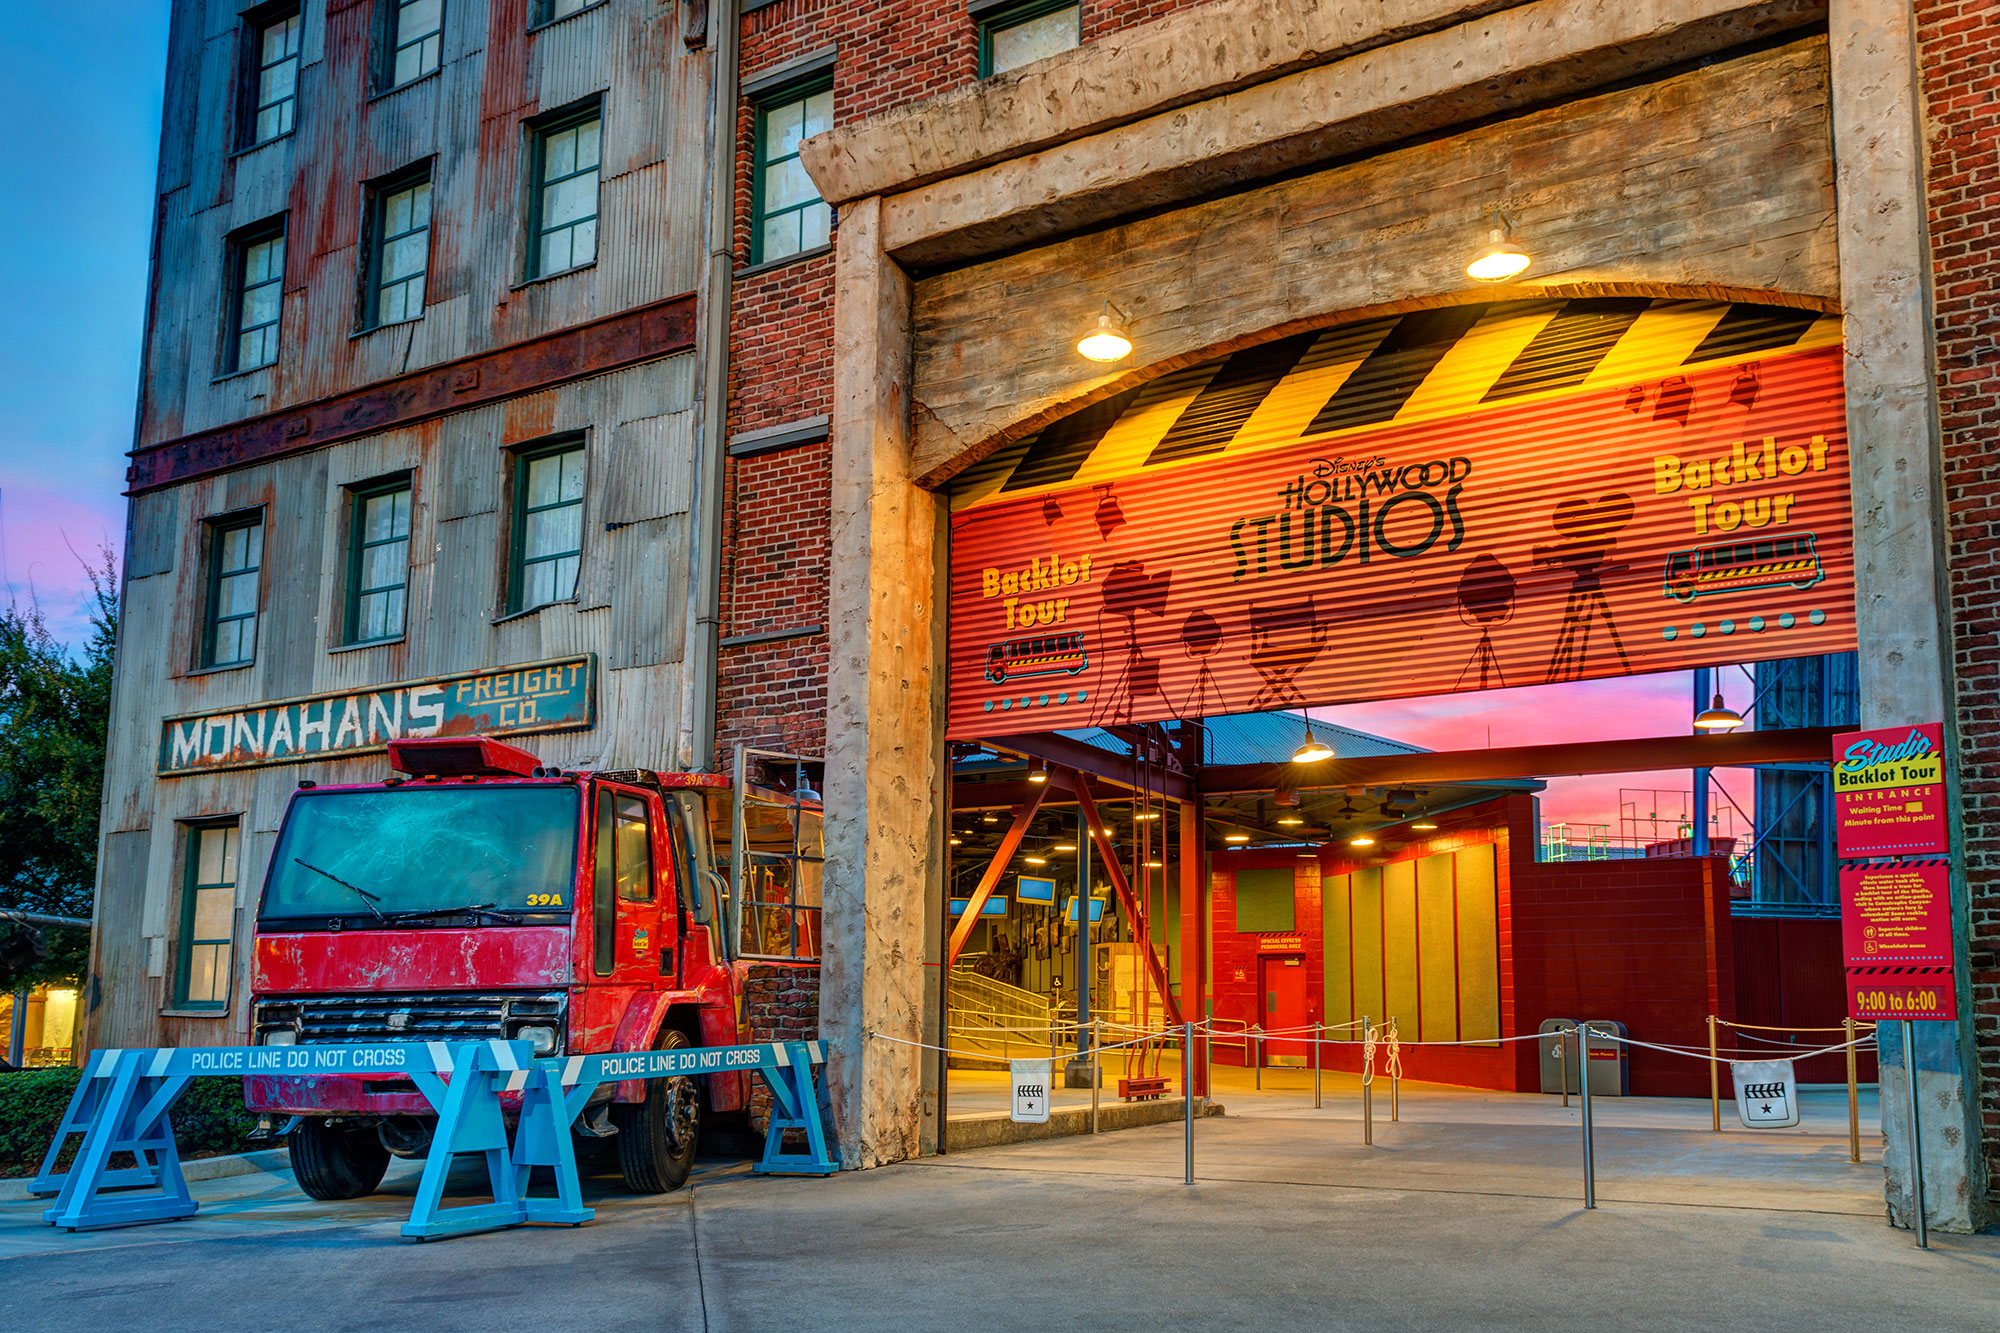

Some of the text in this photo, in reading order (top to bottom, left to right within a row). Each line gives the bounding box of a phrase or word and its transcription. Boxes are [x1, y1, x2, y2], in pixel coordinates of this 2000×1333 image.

[1654, 435, 1829, 494] Backlot
[1278, 457, 1471, 510] HOLLYWOOD
[1688, 493, 1795, 534] Tour
[1230, 483, 1464, 582] STUDIOS
[982, 554, 1092, 598] Backlot
[1003, 598, 1070, 630] Tour
[457, 662, 583, 702] FREIGHT
[500, 699, 541, 726] CO.
[1842, 728, 1932, 772] Studio
[1839, 766, 1935, 786] Backlot Tour
[1846, 788, 1930, 802] ENTRANCE
[1844, 819, 1872, 827] Minute
[1896, 815, 1911, 823] this
[1912, 814, 1935, 823] point
[1849, 804, 1903, 815] Waiting Time
[526, 893, 562, 906] 39A
[1856, 991, 1936, 1010] 9:00 to 6:00
[191, 1049, 406, 1069] POLICE LINE DO NOT CROSS
[601, 1049, 761, 1075] POLICE LINE DO NOT CROSS
